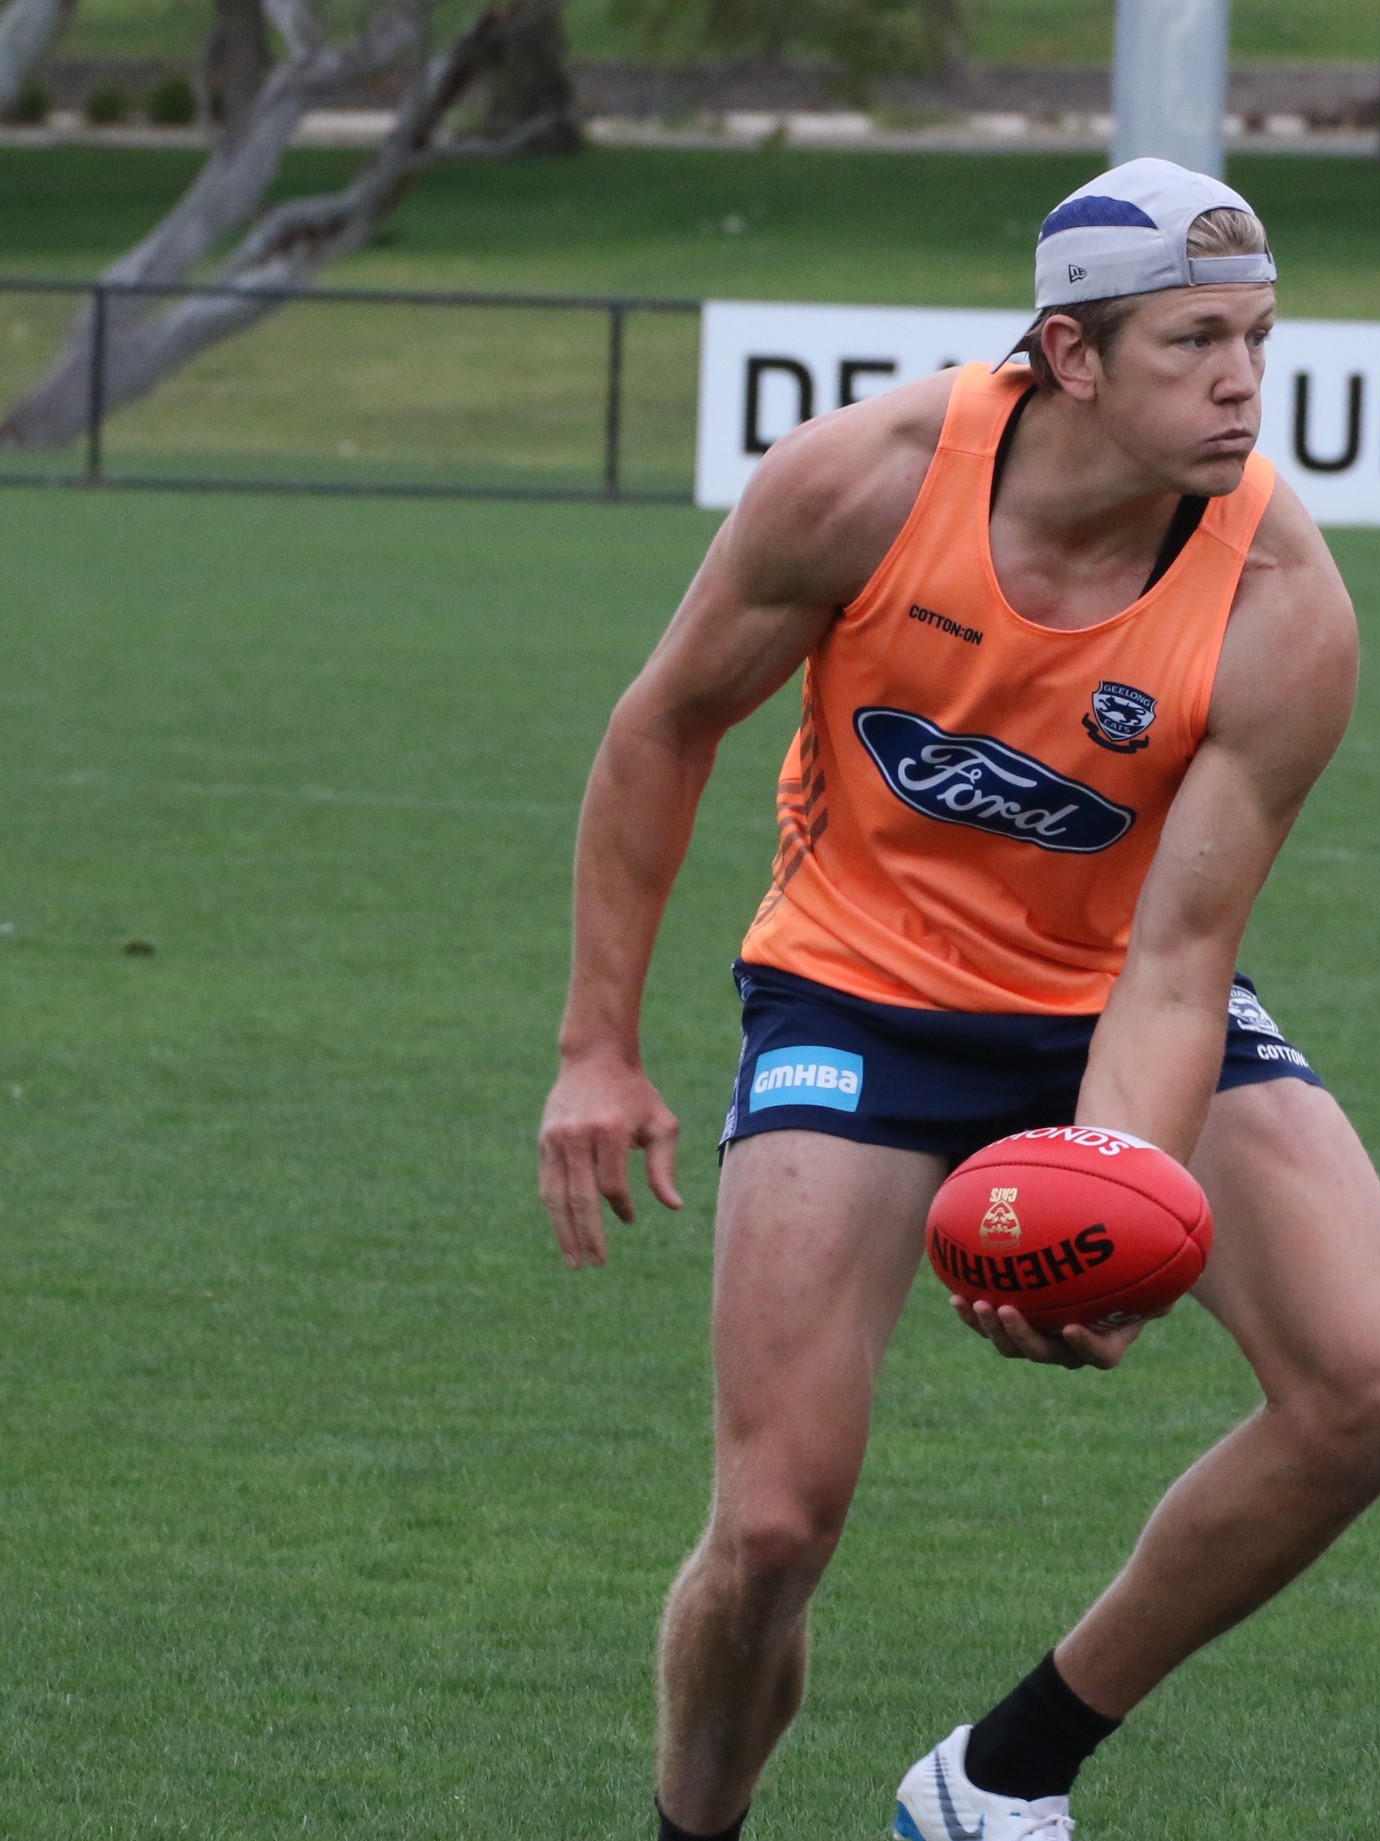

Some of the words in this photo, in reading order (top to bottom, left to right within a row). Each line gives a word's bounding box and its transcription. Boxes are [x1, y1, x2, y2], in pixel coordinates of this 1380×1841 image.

[908, 604, 984, 646] COTTON:ON
[1103, 684, 1152, 708] GEELONG
[1103, 718, 1131, 734] CATS
[898, 745, 1080, 837] Ford
[989, 1187, 1018, 1203] CATS
[931, 1222, 1116, 1293] SHERRIN
